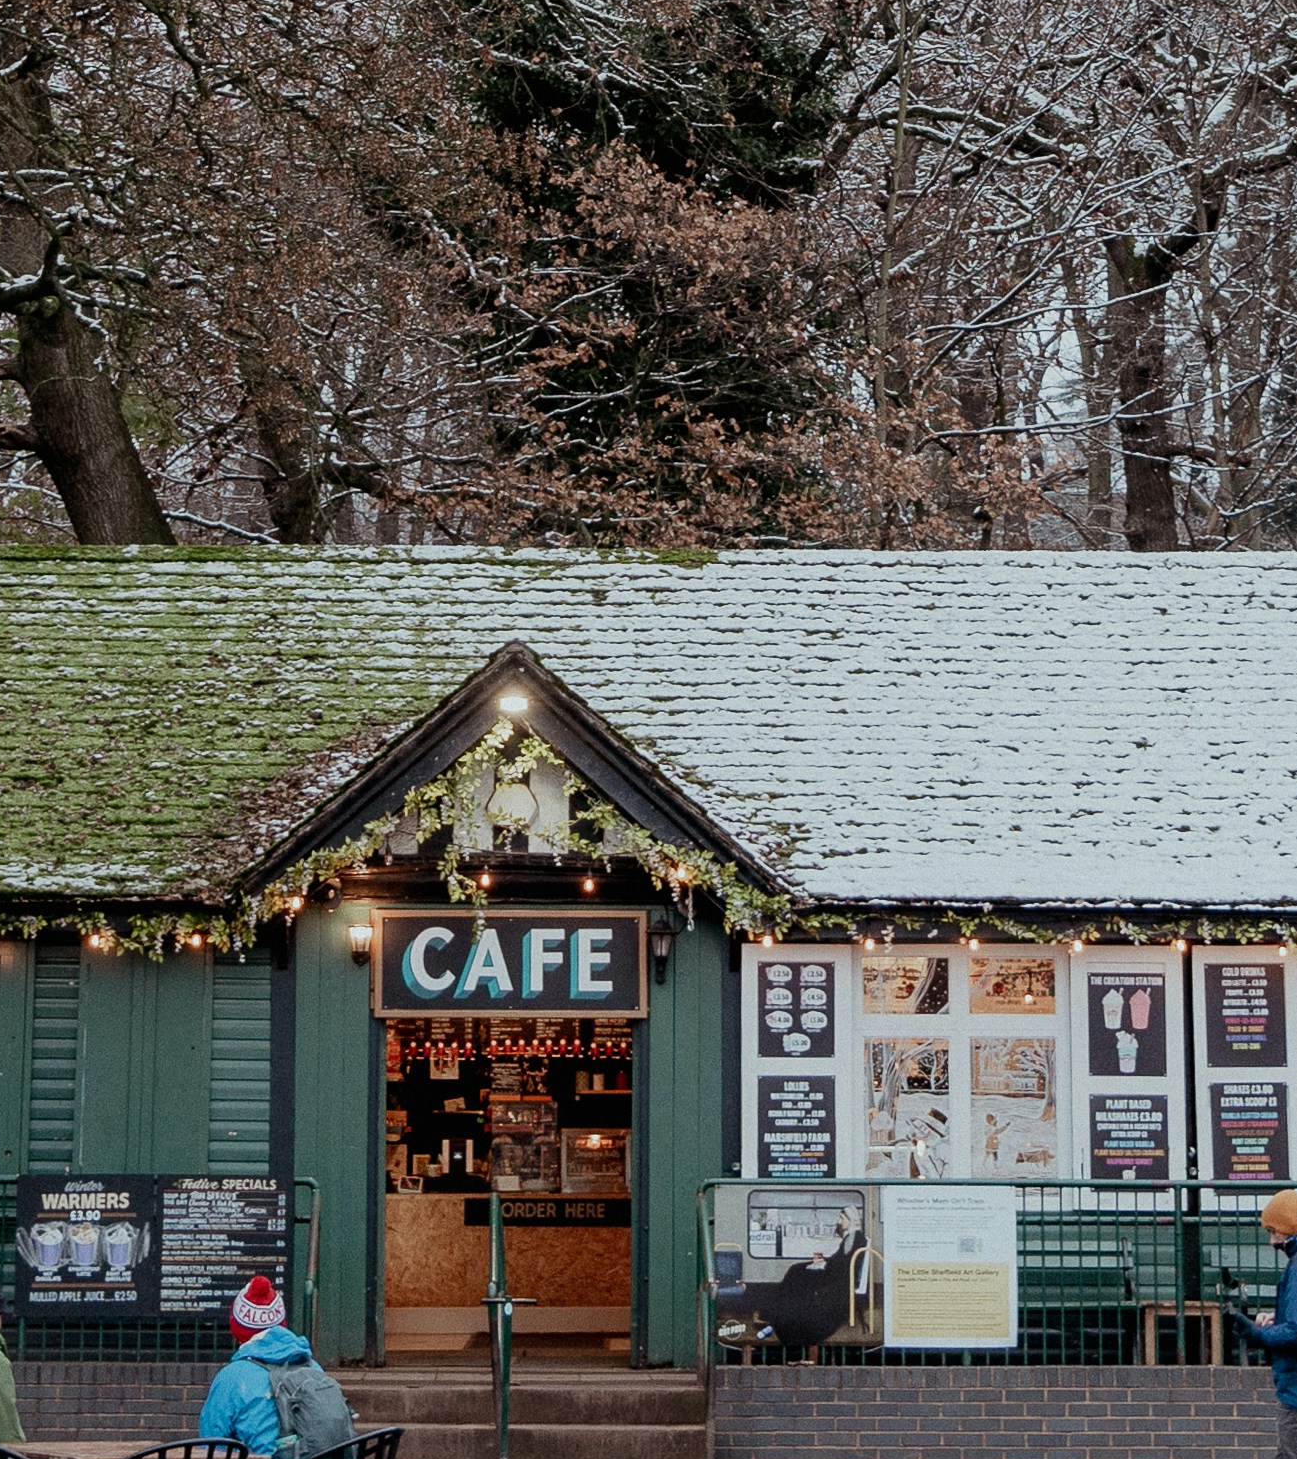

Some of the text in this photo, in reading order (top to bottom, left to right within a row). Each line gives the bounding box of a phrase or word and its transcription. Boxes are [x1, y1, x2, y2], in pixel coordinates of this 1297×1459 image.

[403, 927, 613, 999] CAFE
[181, 1178, 277, 1190] Festive SPECIALS
[41, 1192, 130, 1210] WARMERS
[69, 1210, 101, 1221] £3.90
[502, 1202, 605, 1218] ORDER HERE
[29, 1291, 58, 1302] MULLED
[58, 1291, 81, 1301] APPLE
